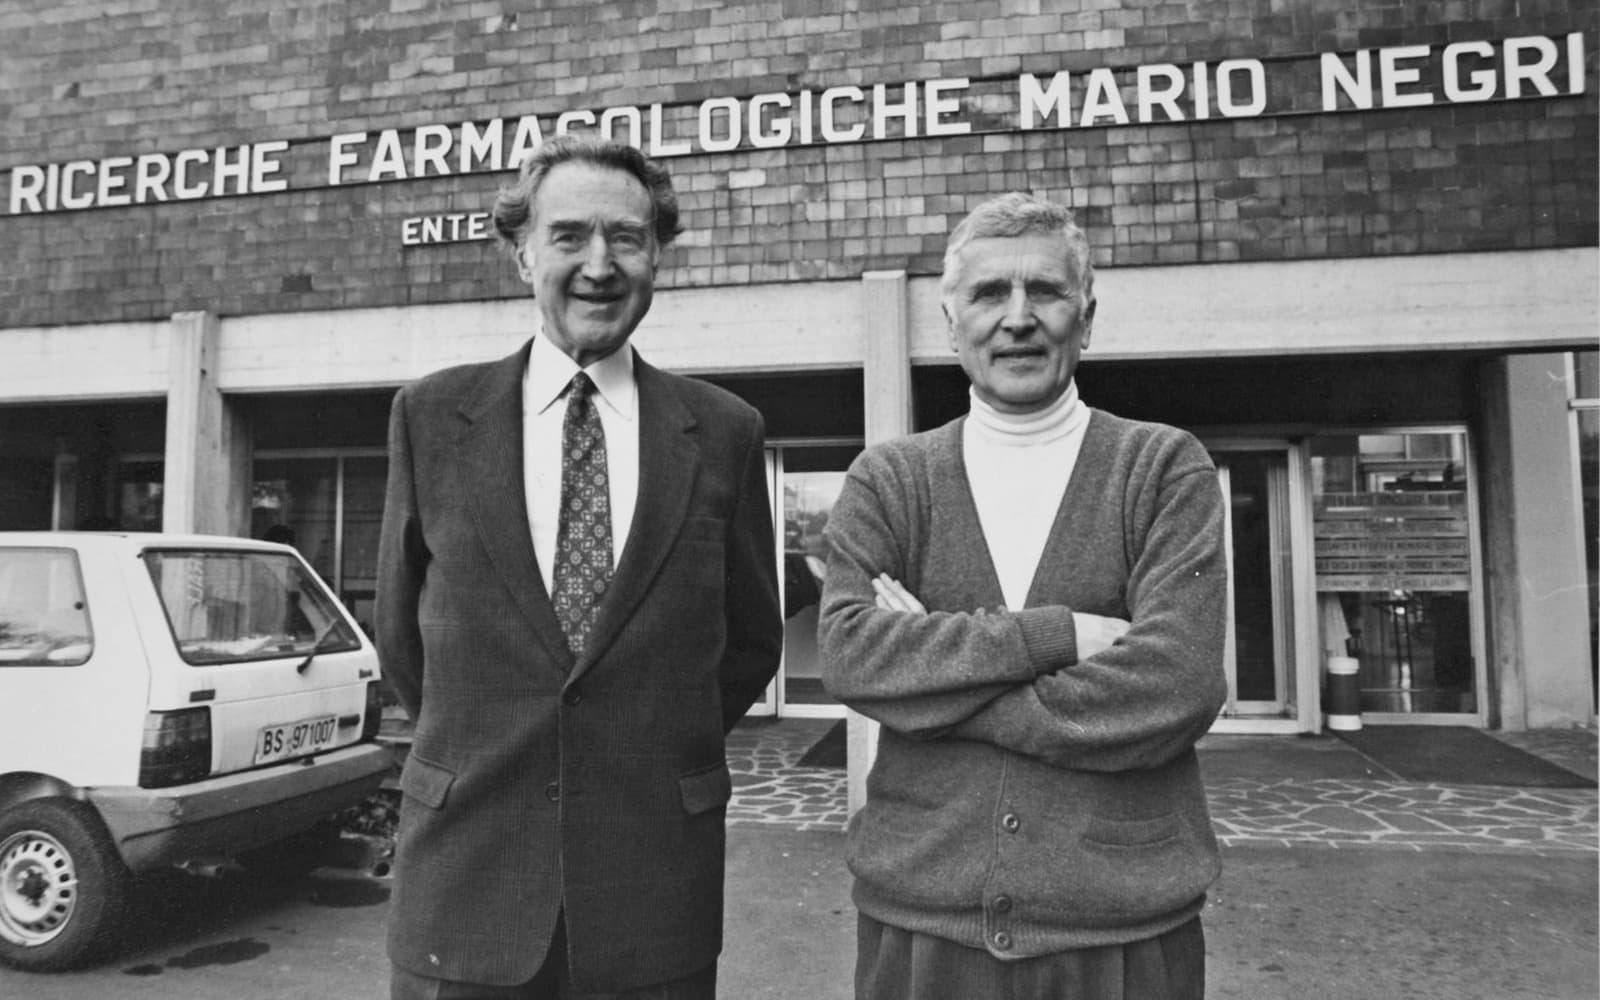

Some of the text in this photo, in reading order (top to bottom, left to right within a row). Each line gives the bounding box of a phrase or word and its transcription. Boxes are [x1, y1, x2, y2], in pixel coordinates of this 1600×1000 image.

[10, 140, 289, 214] RICERCHE
[1018, 58, 1267, 130] MARIO
[1321, 32, 1585, 111] NEGRI
[402, 213, 489, 245] ENTE
[263, 718, 336, 756] BS 971007
